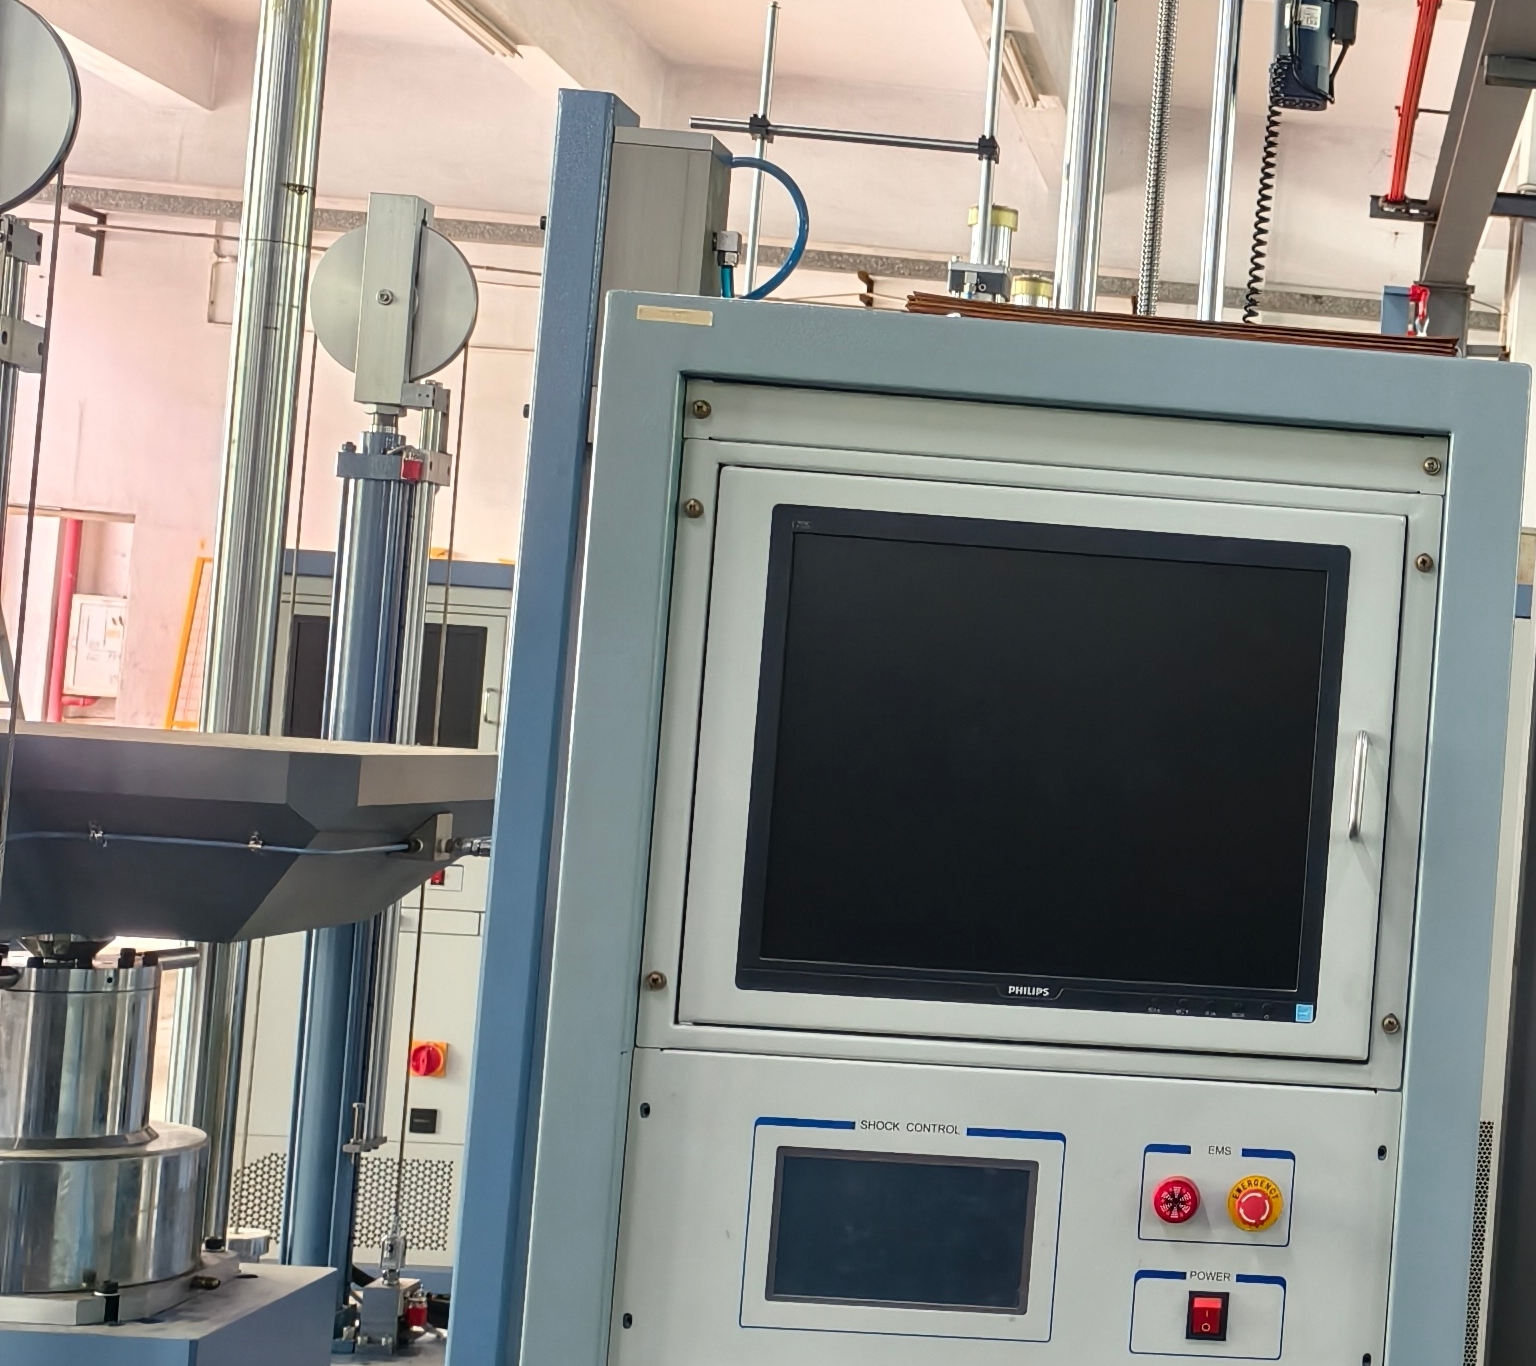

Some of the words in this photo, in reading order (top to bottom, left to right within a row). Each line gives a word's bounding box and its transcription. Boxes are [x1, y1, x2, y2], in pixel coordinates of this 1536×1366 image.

[1008, 985, 1050, 997] PHILIPS
[860, 1120, 900, 1132] SHOCK
[906, 1123, 960, 1135] CONTROL
[1208, 1145, 1232, 1156] EMS
[1190, 1270, 1231, 1282] POWER
